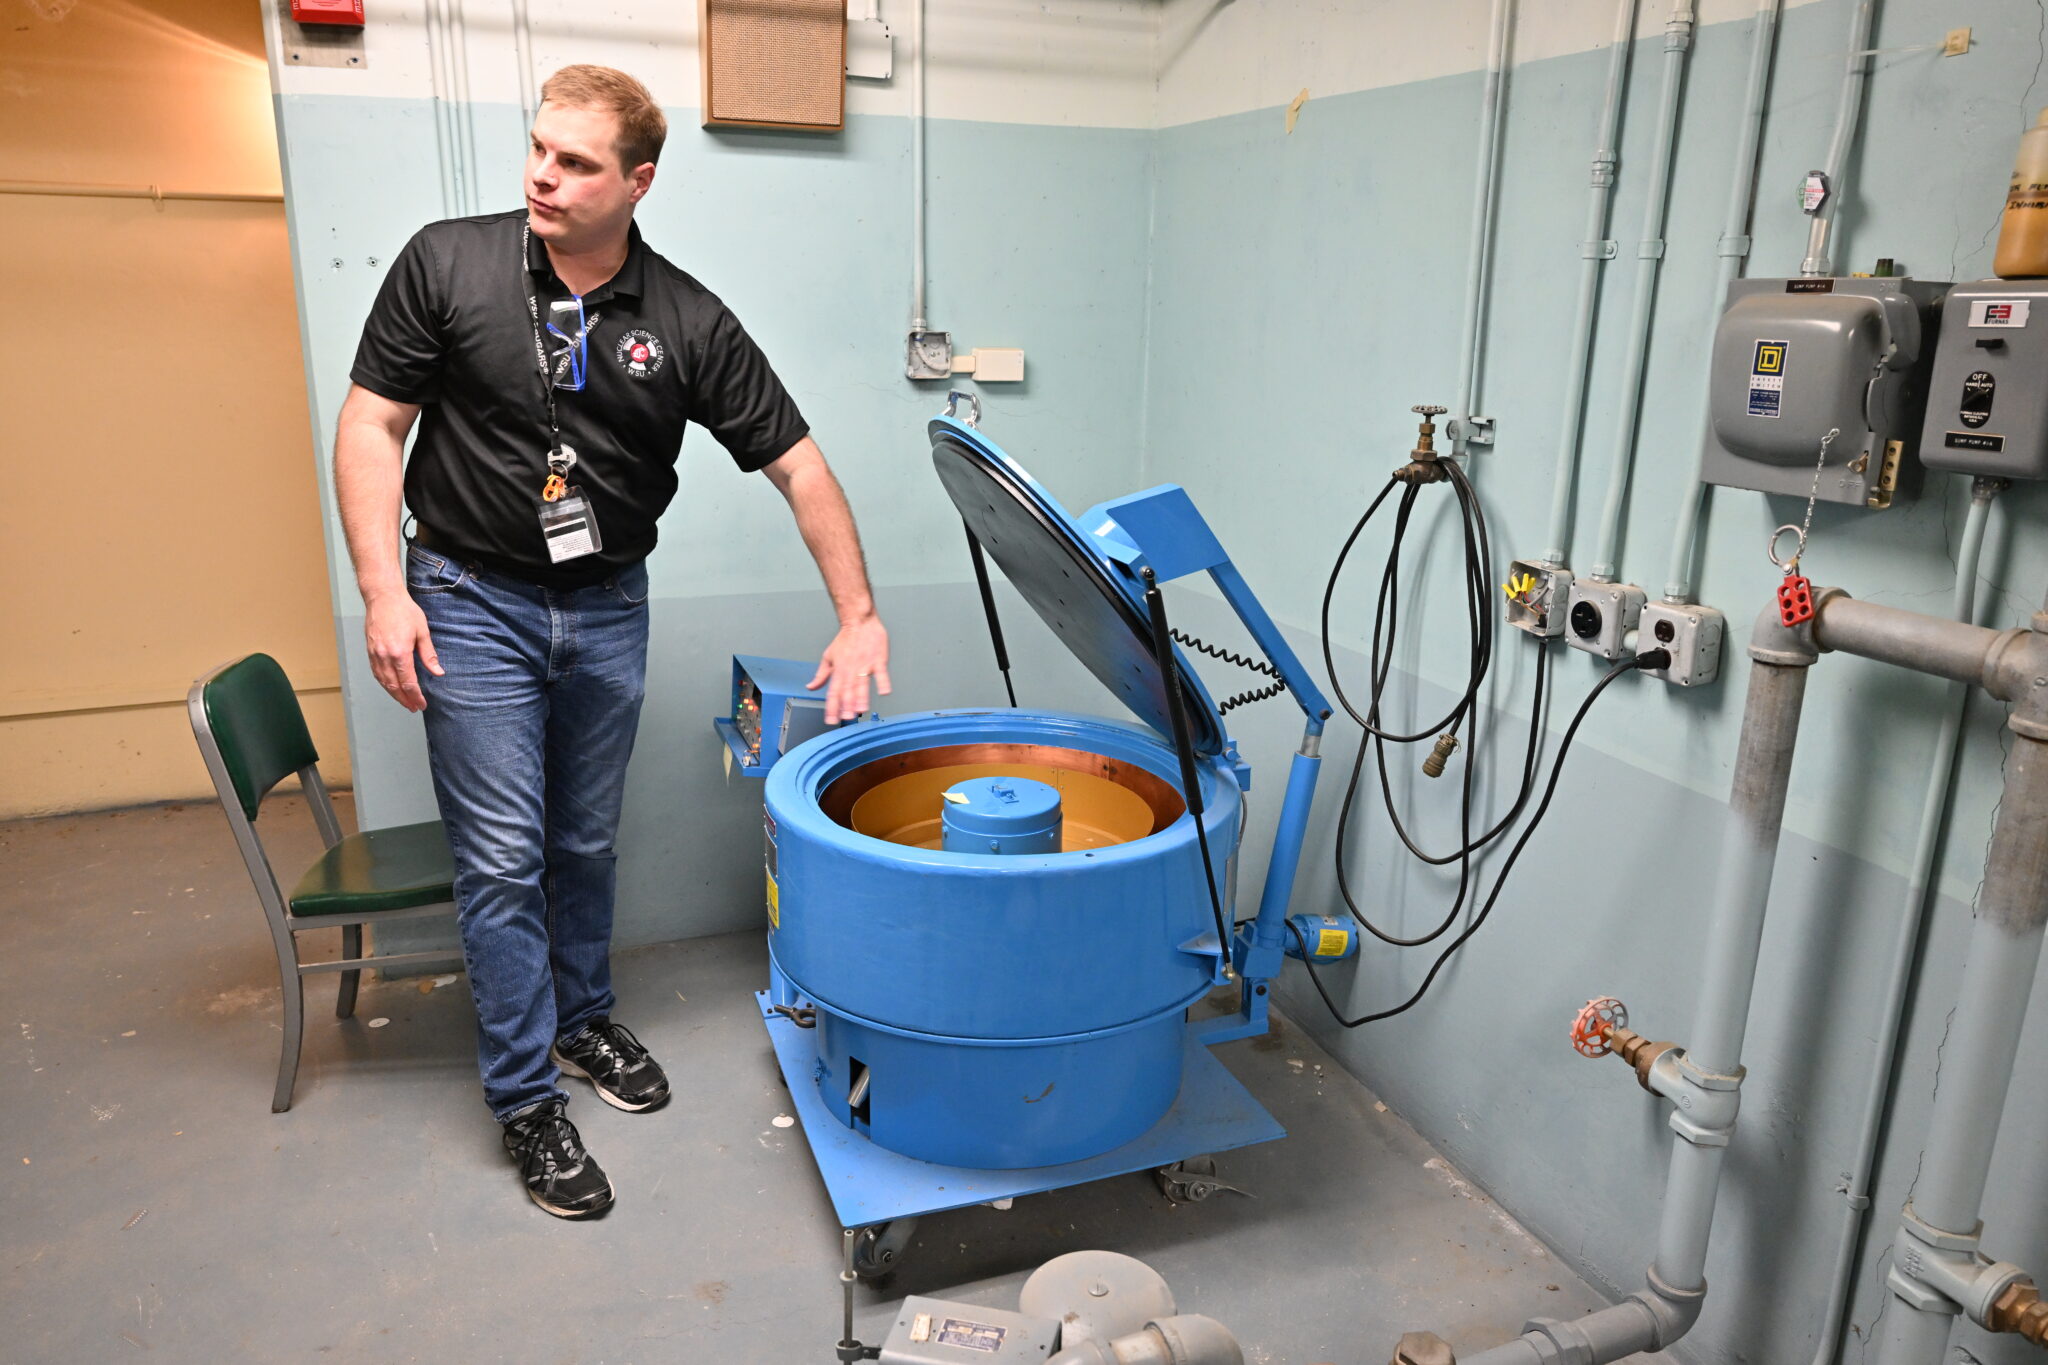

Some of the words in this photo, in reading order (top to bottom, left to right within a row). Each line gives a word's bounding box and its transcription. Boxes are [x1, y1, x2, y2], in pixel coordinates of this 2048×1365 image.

[616, 332, 631, 363] NUCLEAR
[630, 329, 660, 345] SCIENCE
[651, 345, 664, 372] CENTER
[556, 354, 571, 375] WSU
[627, 367, 645, 377] WSU
[1972, 373, 1988, 381] OFF
